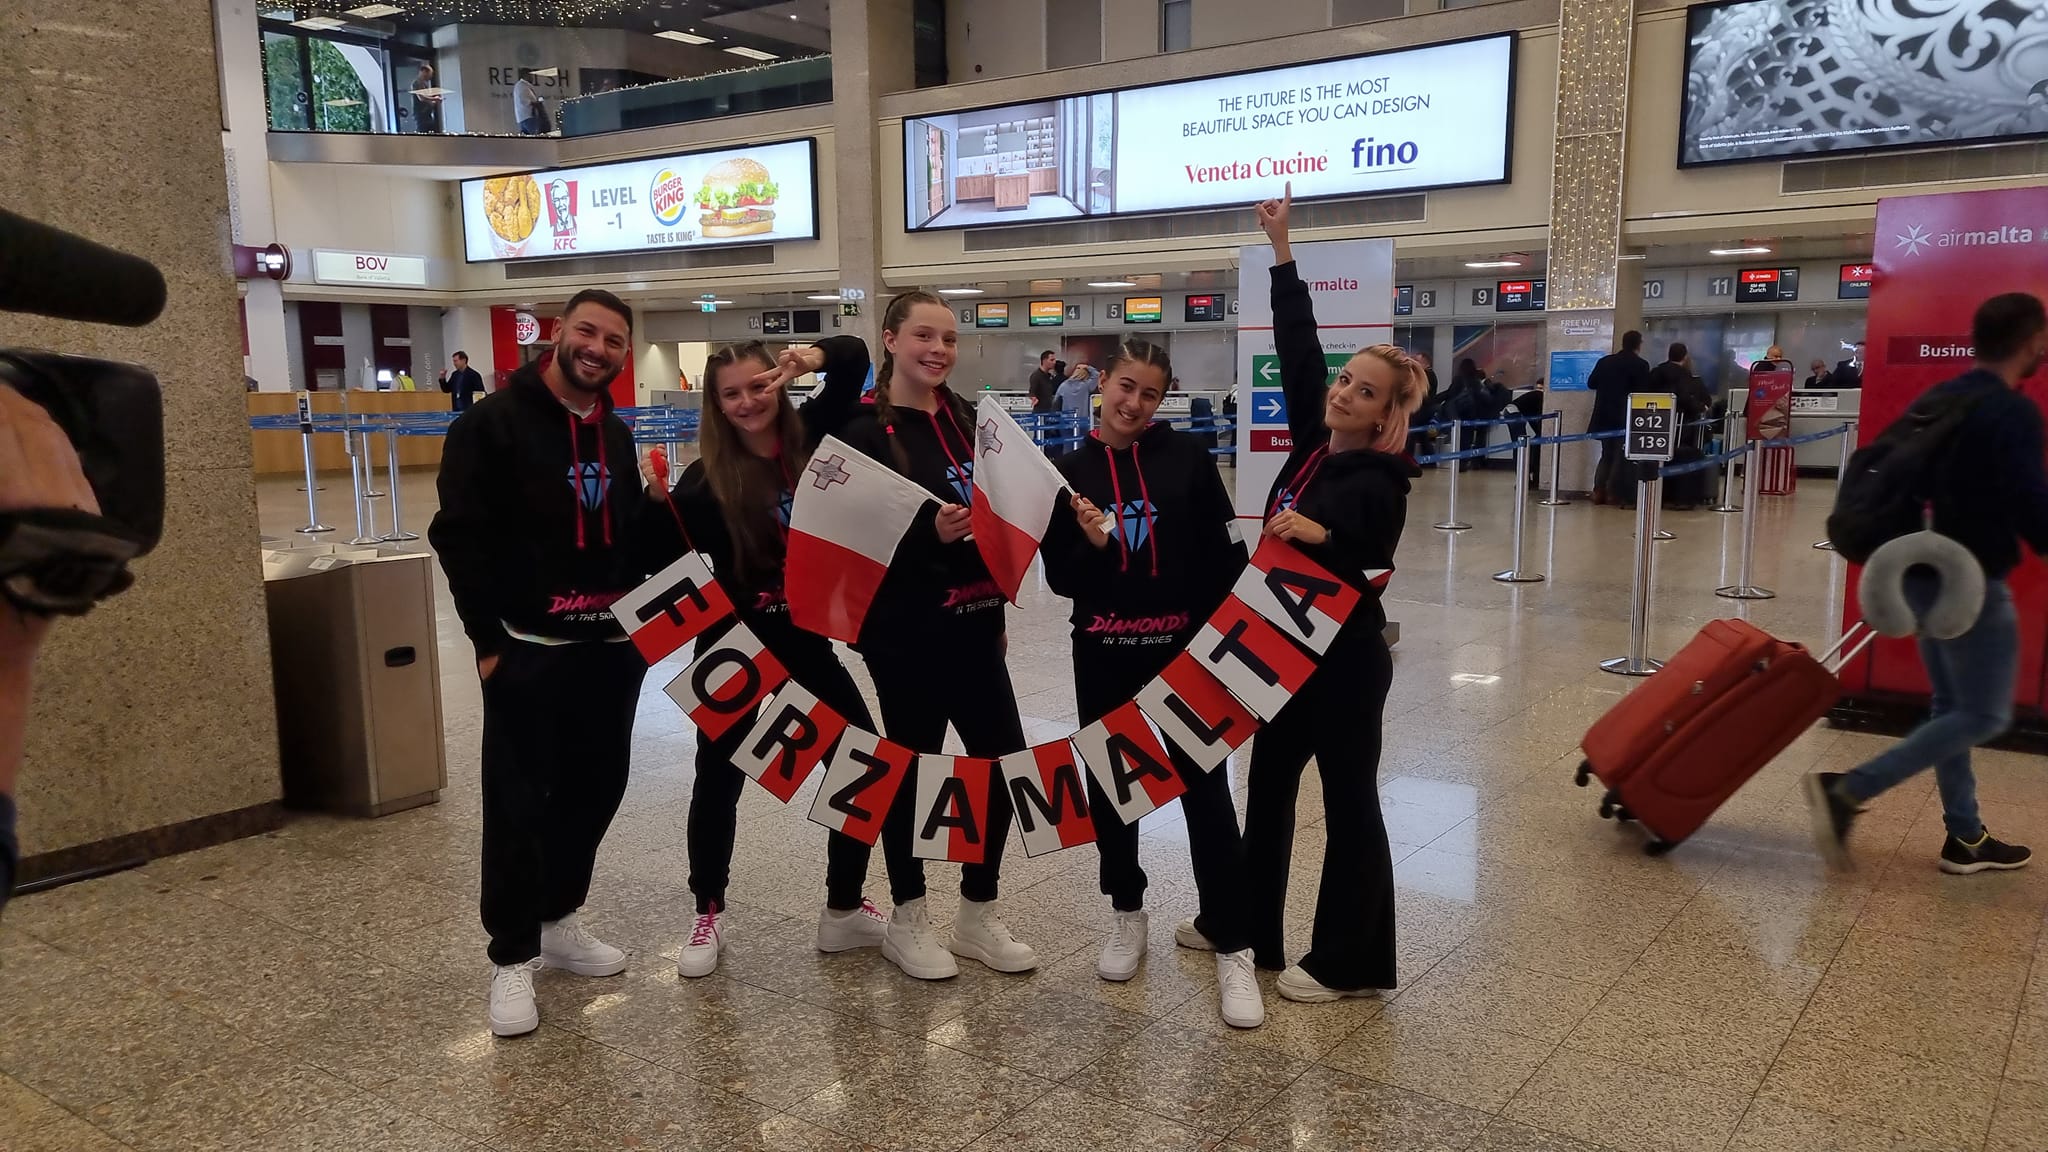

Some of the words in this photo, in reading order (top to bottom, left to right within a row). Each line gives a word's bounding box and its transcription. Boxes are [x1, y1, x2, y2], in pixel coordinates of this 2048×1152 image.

[1219, 96, 1242, 113] THE
[1246, 89, 1296, 110] FUTURE
[1300, 88, 1312, 103] IS
[1317, 83, 1342, 99] THE
[1346, 77, 1390, 96] MOST
[1182, 116, 1248, 137] BEAUTIFUL
[1252, 110, 1294, 130] SPACE
[1299, 106, 1329, 123] YOU
[1333, 102, 1367, 119] CAN
[1372, 94, 1431, 115] DESIGN
[1352, 137, 1418, 168] fino
[1184, 160, 1251, 184] Veneta
[1255, 151, 1328, 178] Cucine
[653, 176, 682, 200] BURGER
[592, 186, 637, 208] LEVEL
[655, 188, 684, 214] KING
[608, 212, 622, 230] -1
[554, 238, 577, 250] KFC
[646, 233, 666, 244] TASTE
[667, 232, 674, 243] IS
[1938, 226, 2032, 248] airmalta
[356, 256, 388, 271] BOV
[1306, 278, 1358, 292] irmalta
[1643, 282, 1661, 298] 10
[1712, 280, 1728, 295] 11
[1421, 292, 1430, 306] 8
[1478, 290, 1487, 304] 9
[1068, 307, 1076, 319] 4
[1110, 305, 1118, 317] 5
[1232, 300, 1239, 313] 6
[964, 311, 970, 321] 3
[517, 322, 534, 331] ost
[750, 318, 761, 329] 1A
[1920, 344, 1976, 358] Busine
[1646, 416, 1662, 429] 12
[1639, 436, 1654, 449] 13
[1118, 637, 1138, 645] THE
[1140, 635, 1173, 645] SKIES
